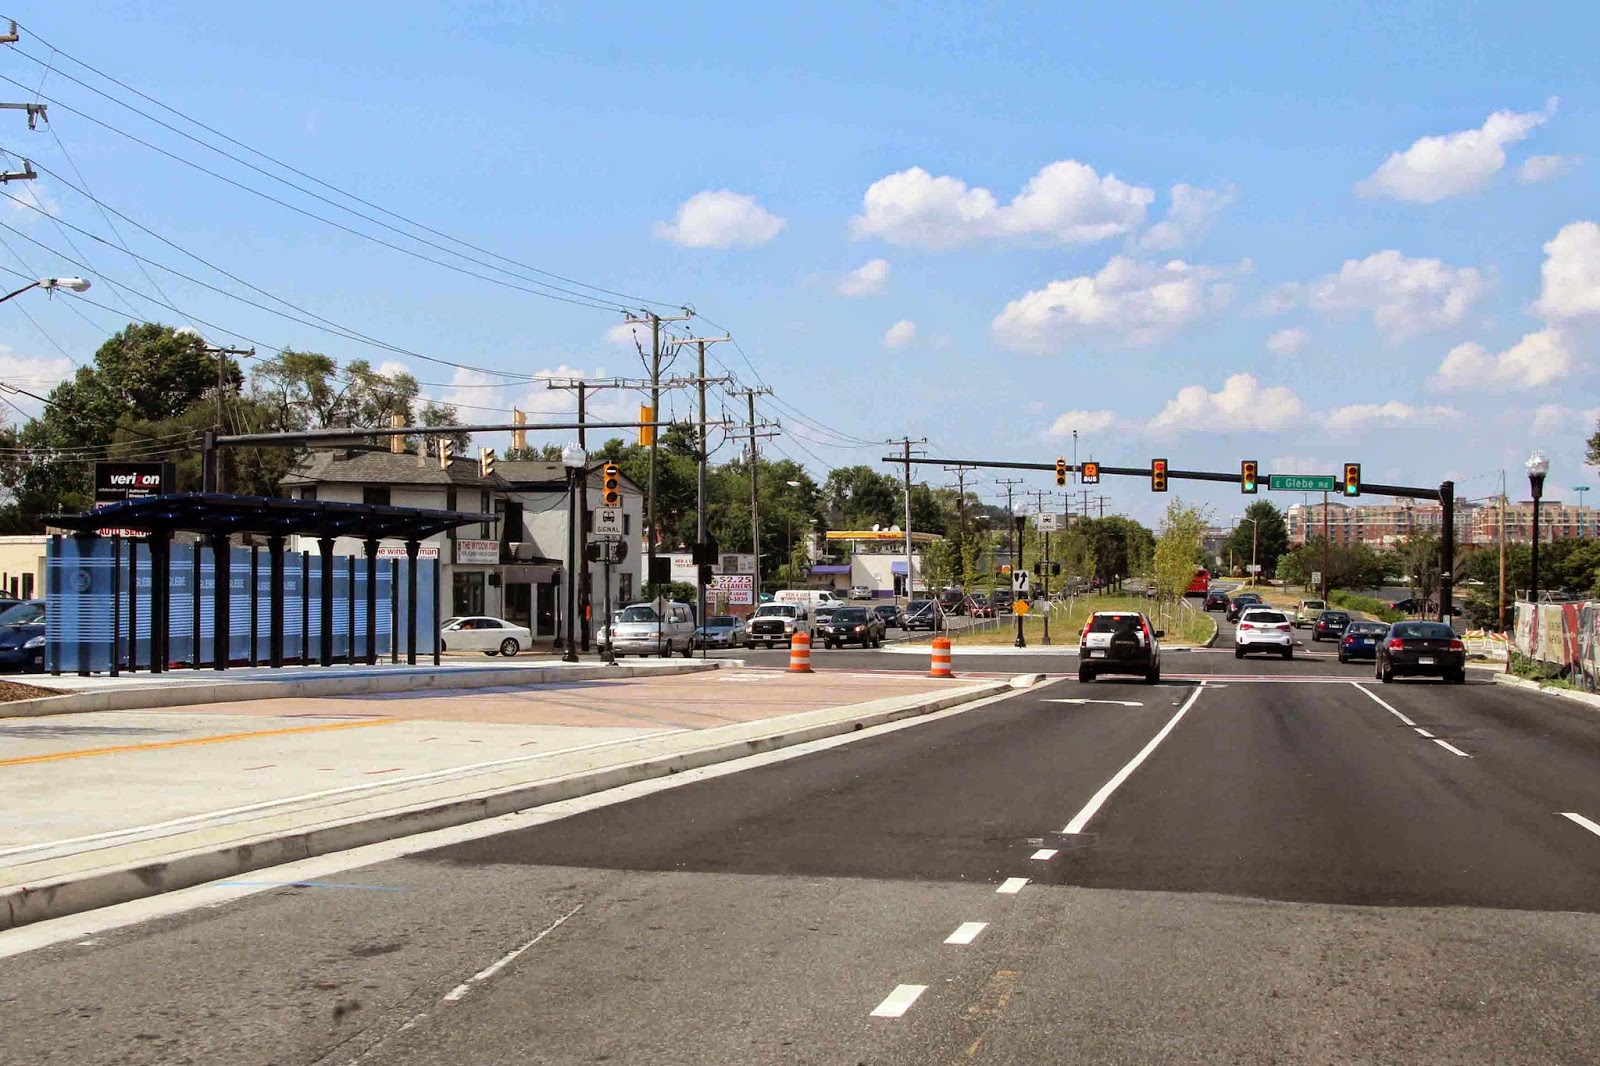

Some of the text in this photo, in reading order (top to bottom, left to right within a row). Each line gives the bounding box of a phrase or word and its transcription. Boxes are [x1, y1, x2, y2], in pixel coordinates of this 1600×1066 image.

[110, 472, 160, 487] verizon
[1285, 478, 1314, 489] Glebe
[100, 528, 120, 536] AUTO
